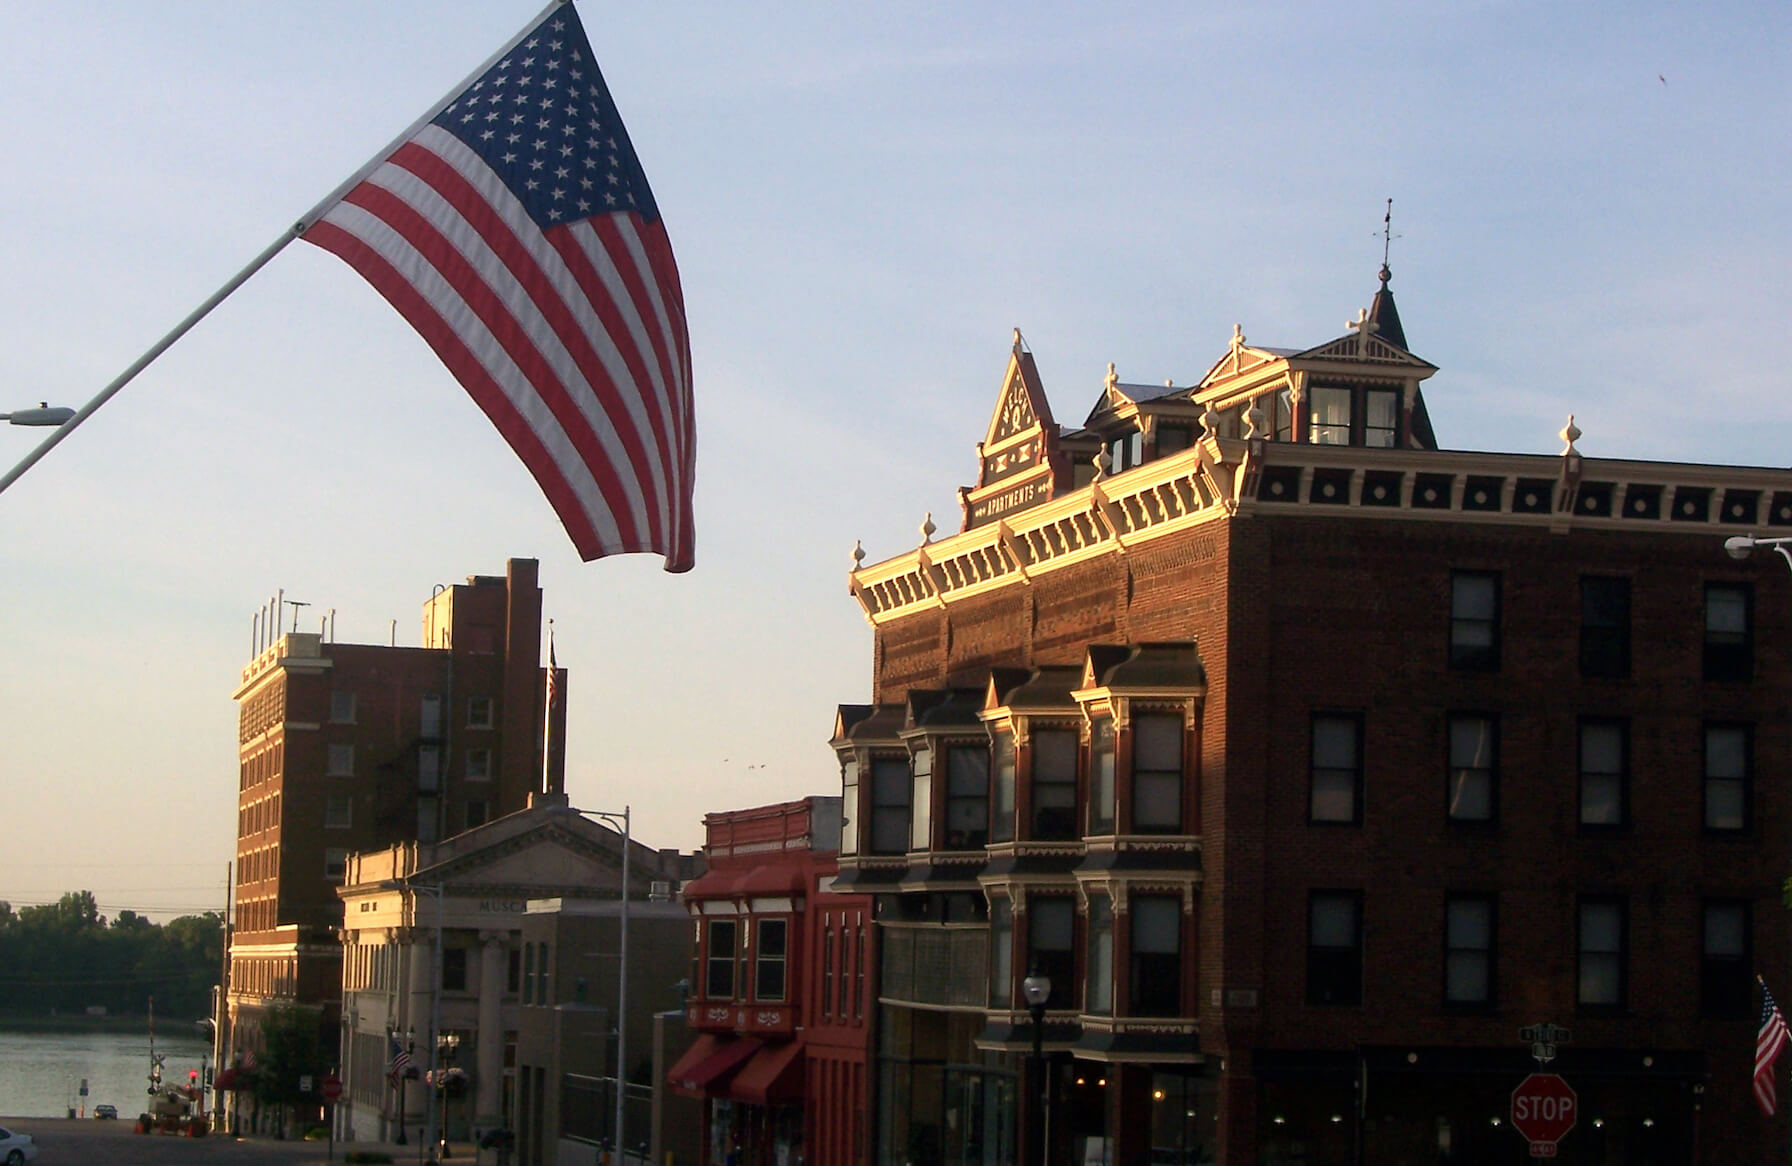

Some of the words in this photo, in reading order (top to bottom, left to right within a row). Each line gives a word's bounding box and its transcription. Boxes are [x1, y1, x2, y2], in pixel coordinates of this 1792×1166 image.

[1003, 387, 1028, 424] WELCH
[987, 484, 1034, 516] APARTMENTS
[1515, 1095, 1573, 1121] STOP
